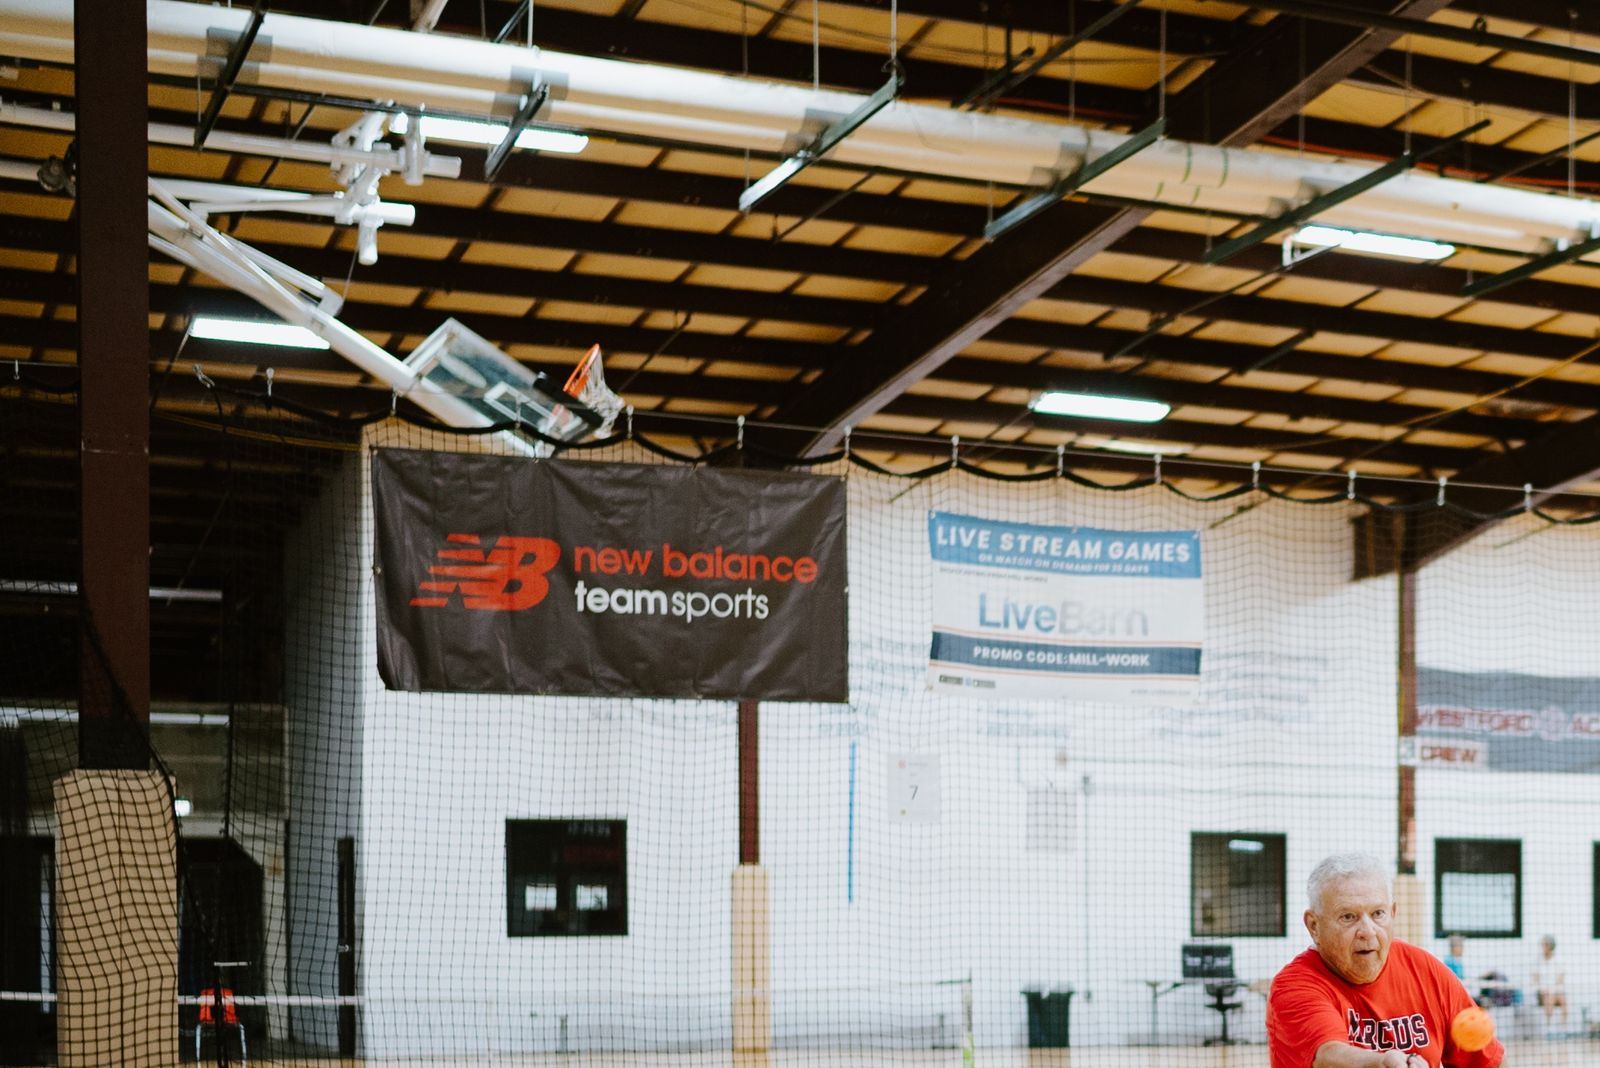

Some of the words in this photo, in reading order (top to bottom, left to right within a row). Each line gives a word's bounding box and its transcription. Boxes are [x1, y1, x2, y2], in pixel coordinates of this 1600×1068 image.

[937, 525, 992, 549] LIVE
[1000, 532, 1103, 559] STREAM
[1108, 541, 1191, 562] GAMES
[574, 545, 653, 576] new
[662, 543, 818, 582] balance
[995, 555, 1032, 568] WATCH
[1034, 558, 1050, 569] ON
[1052, 560, 1093, 572] DEMAND
[978, 591, 1149, 636] LiveBarn
[972, 646, 1023, 662] PROMO
[909, 784, 919, 801] 7
